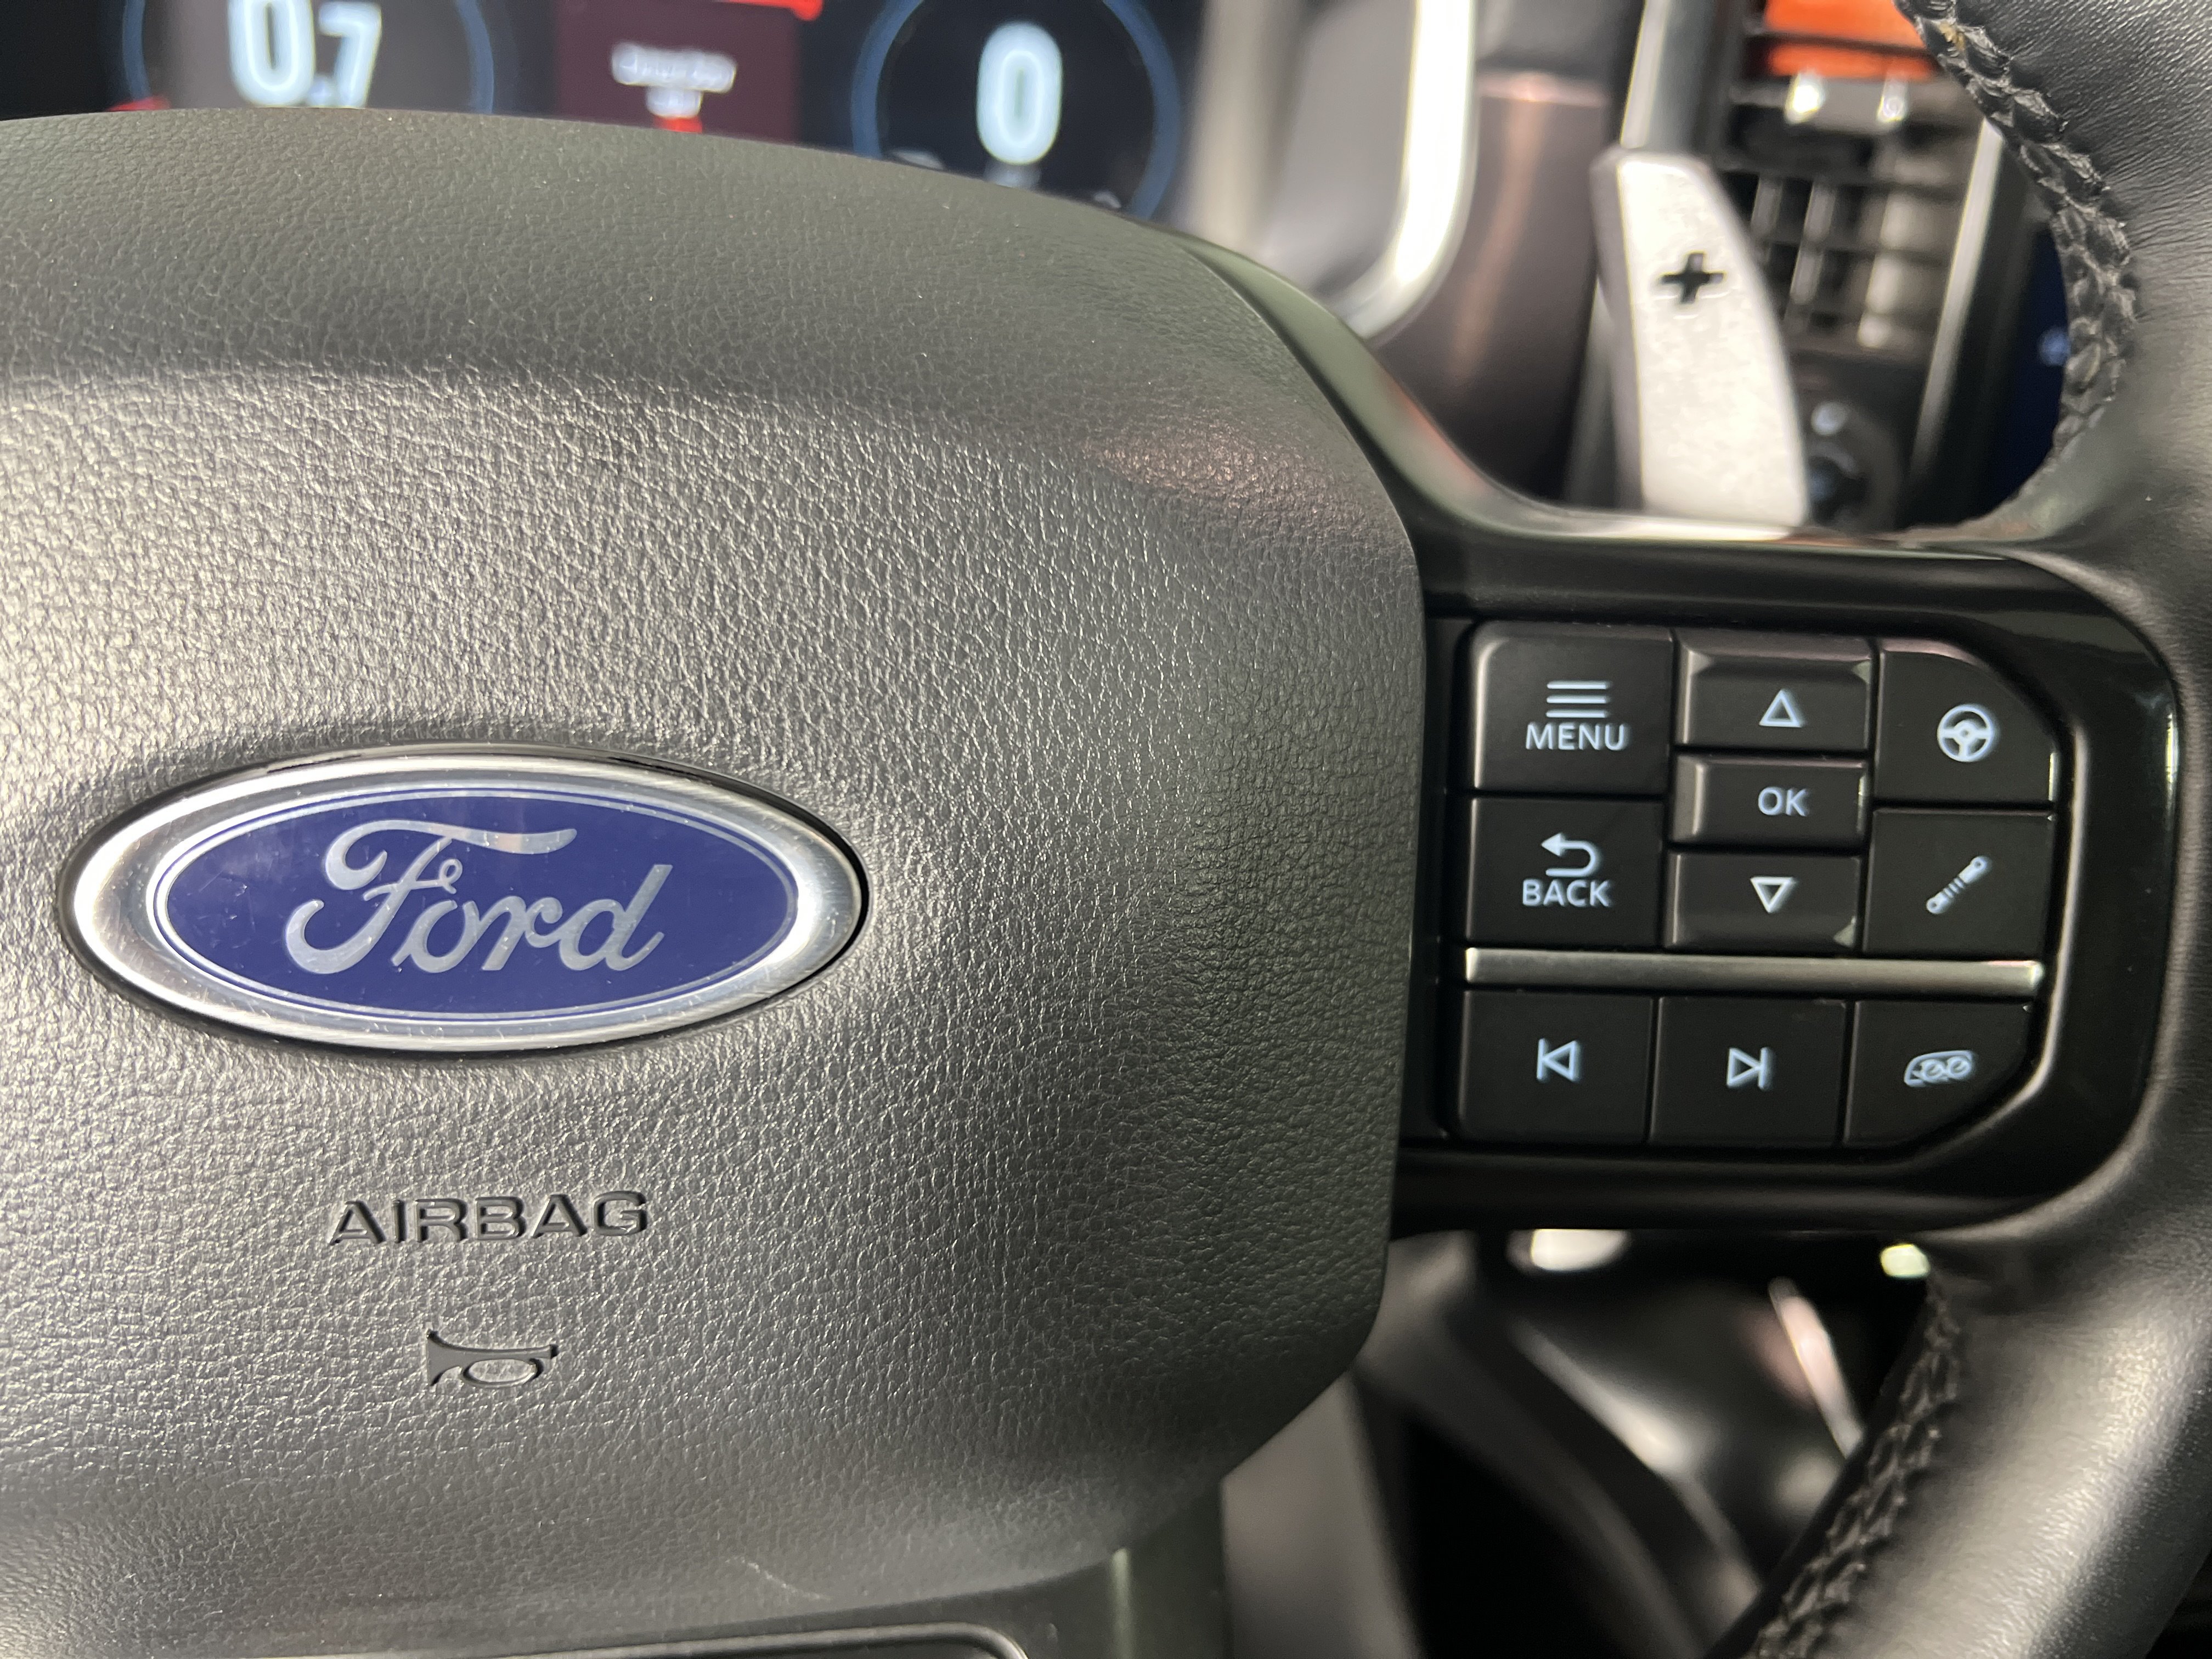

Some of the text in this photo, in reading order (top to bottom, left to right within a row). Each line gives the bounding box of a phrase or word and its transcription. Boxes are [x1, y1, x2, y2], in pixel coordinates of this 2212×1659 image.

[977, 21, 1063, 165] 0
[1525, 723, 1630, 751] MENU
[1758, 786, 1810, 816] OK
[285, 819, 674, 974] Ford
[1522, 879, 1612, 907] BACK
[329, 1190, 648, 1246] AIRBAG
